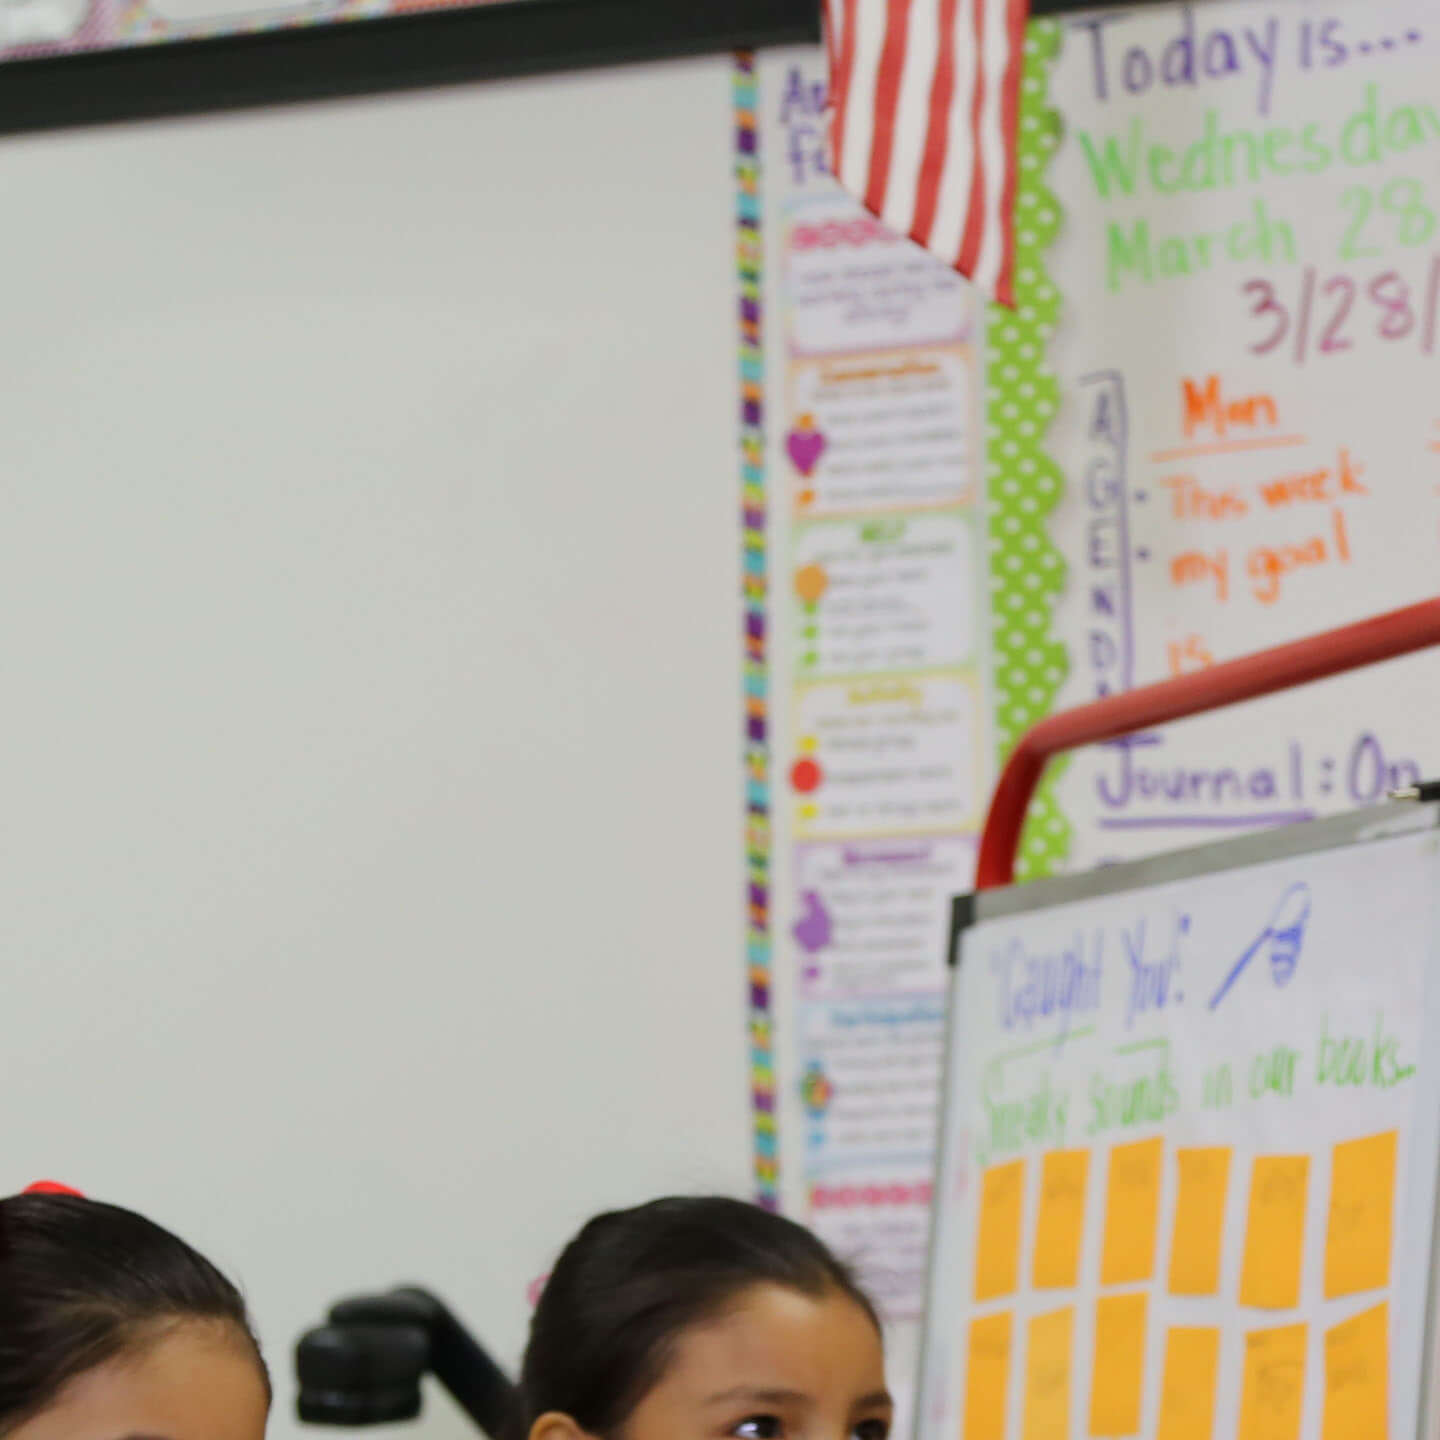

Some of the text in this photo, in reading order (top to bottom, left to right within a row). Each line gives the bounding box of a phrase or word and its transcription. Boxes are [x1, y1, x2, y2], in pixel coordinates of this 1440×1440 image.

[1066, 2, 1278, 117] Today
[1106, 199, 1297, 293] March
[1181, 373, 1278, 437] Mon
[1169, 506, 1352, 607] my goal
[1346, 733, 1421, 804] On
